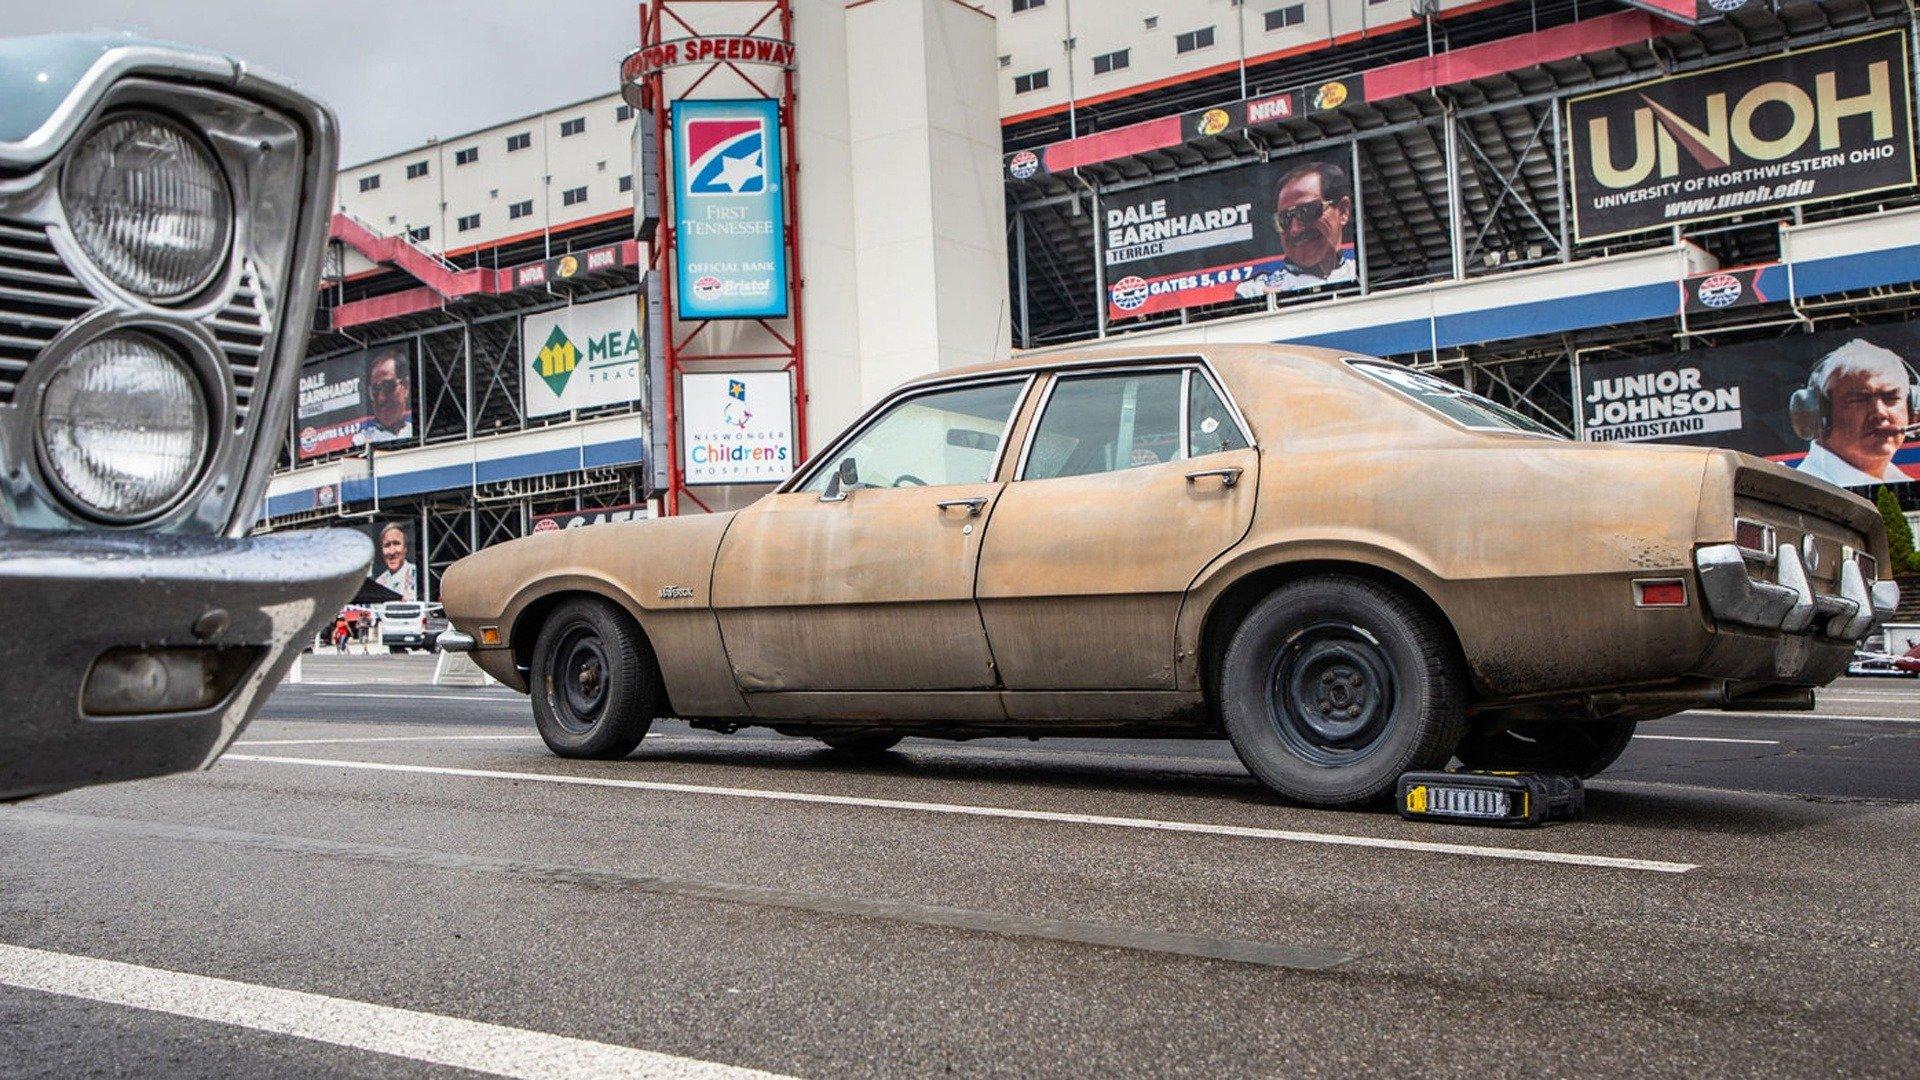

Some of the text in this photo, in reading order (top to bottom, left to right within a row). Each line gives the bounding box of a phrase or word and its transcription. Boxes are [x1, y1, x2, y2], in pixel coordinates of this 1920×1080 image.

[684, 38, 795, 65] SPEEDWAY
[1250, 98, 1288, 121] NRA
[1589, 60, 1894, 189] UNOH
[1594, 144, 1895, 210] UNIVERSITY OF NORTHWESTERN OHIO
[1664, 178, 1816, 219] www.unoh.edu
[706, 205, 748, 220] FIRST
[1107, 199, 1168, 230] DALE
[682, 219, 774, 236] TENNESSEE
[1108, 203, 1252, 249] EARNHARDT
[1111, 243, 1165, 262] TERRACE
[688, 260, 776, 274] OFFICIAL BANK
[1150, 276, 1197, 296] GATES
[1200, 272, 1216, 290] 5,
[1218, 270, 1227, 284] 6
[1243, 265, 1253, 280] 7
[588, 328, 641, 362] MEA
[299, 371, 326, 392] DALE
[1586, 367, 1701, 403] JUNIOR
[1587, 385, 1741, 427] JOHNSON
[694, 432, 784, 441] NISWONGER
[1590, 416, 1705, 442] GRANDSTAND
[691, 443, 787, 464] Children's
[695, 466, 785, 475] HOSPITAL
